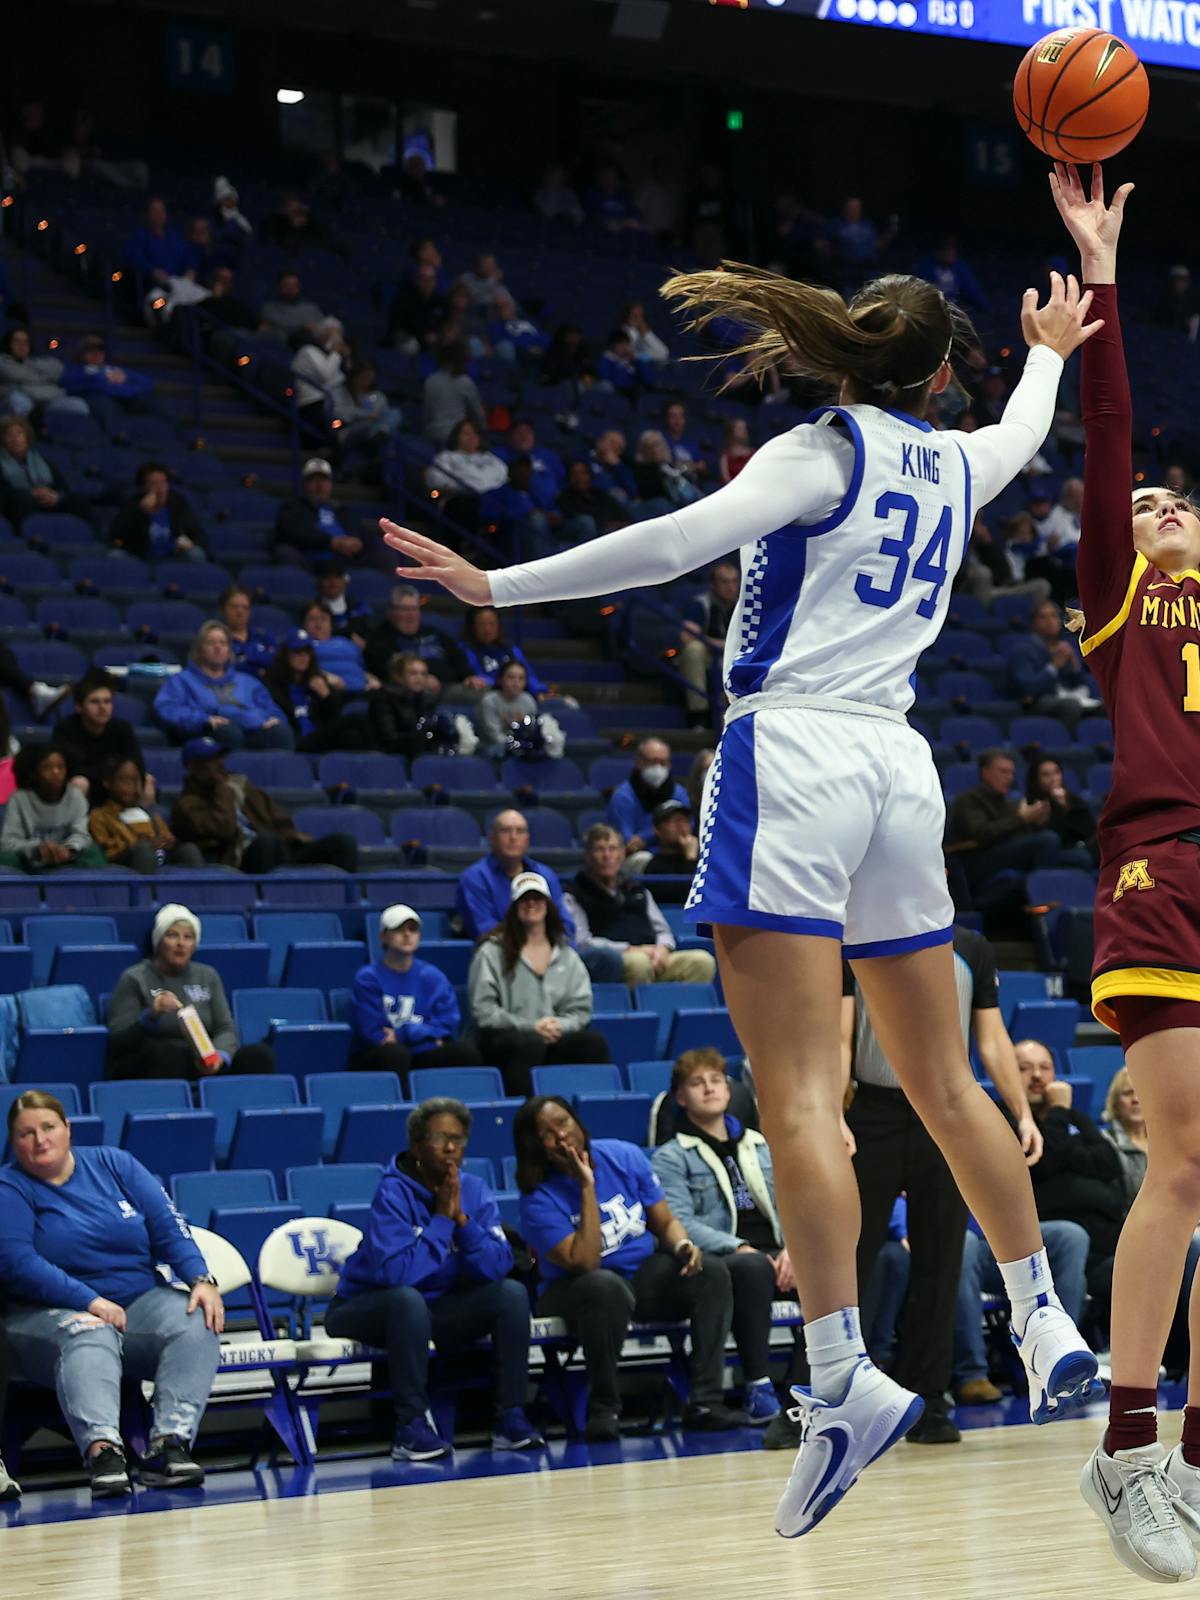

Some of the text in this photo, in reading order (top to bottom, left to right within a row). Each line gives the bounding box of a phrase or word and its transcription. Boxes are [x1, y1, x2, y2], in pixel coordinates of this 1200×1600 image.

[1022, 0, 1113, 33] FIRST
[175, 37, 224, 79] 14
[902, 442, 940, 485] KING
[854, 490, 953, 620] 34
